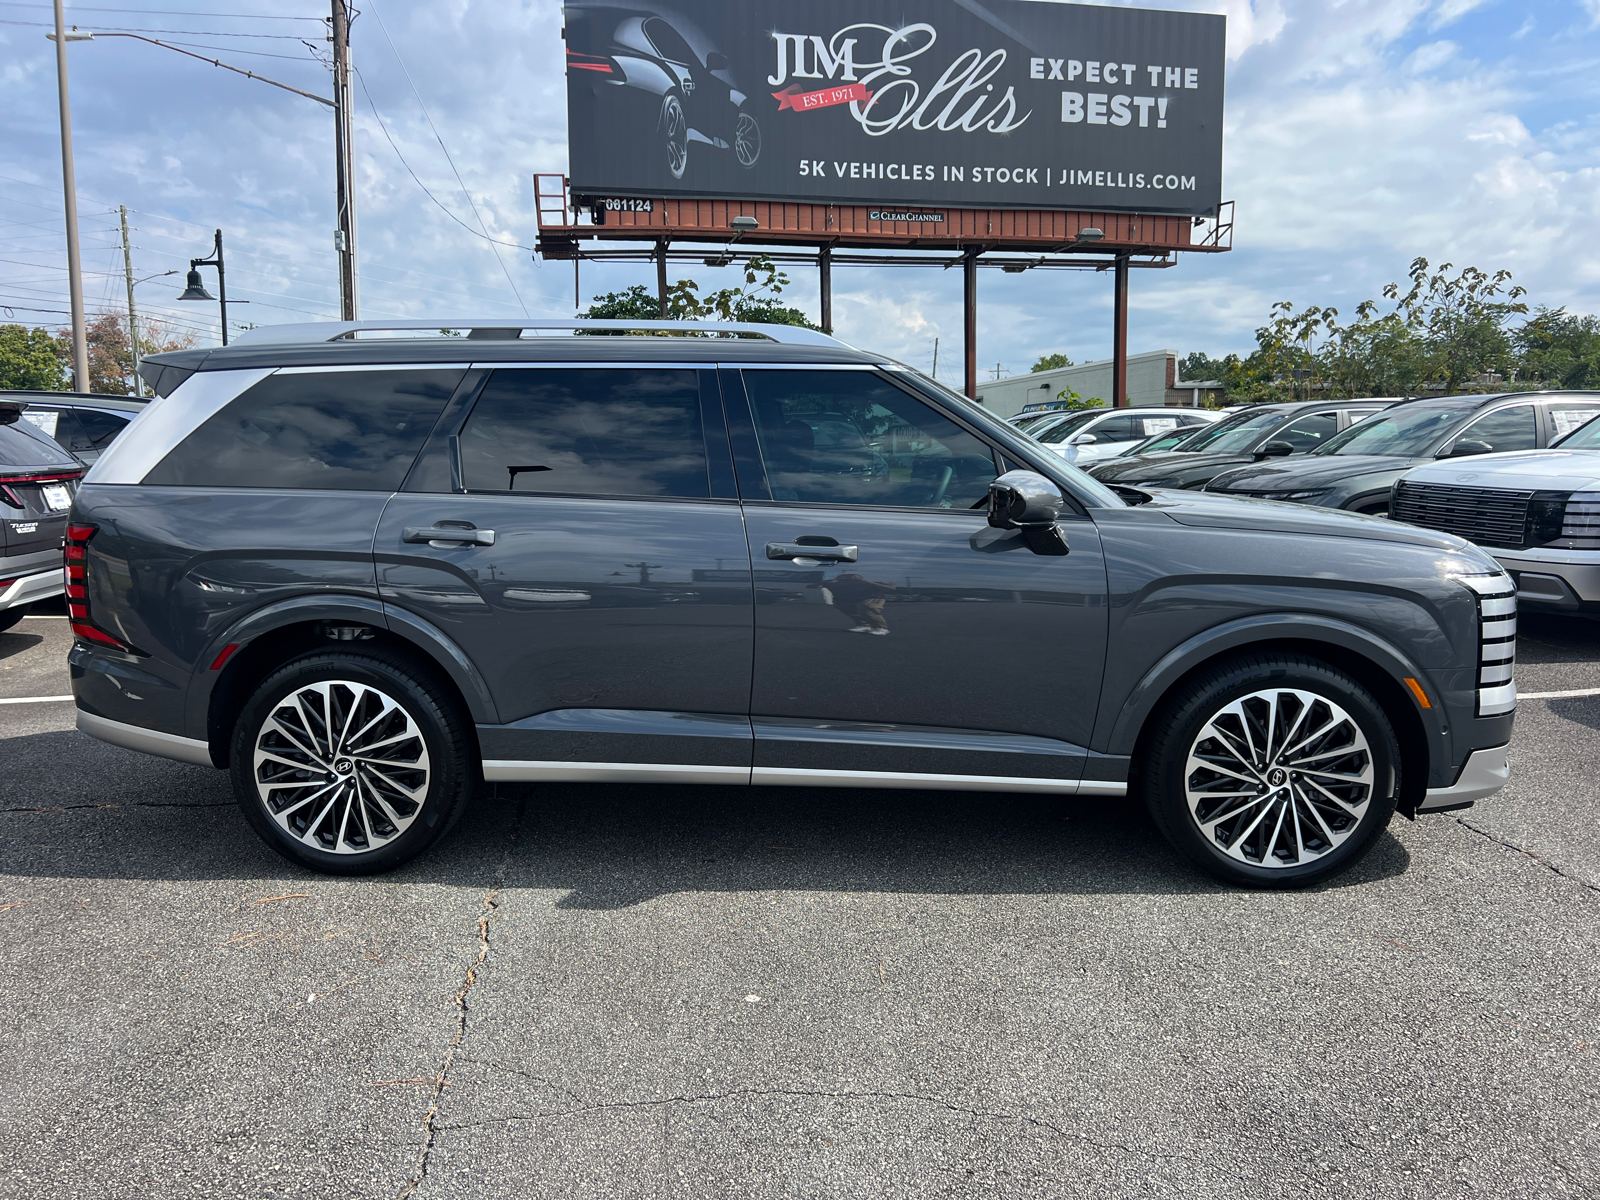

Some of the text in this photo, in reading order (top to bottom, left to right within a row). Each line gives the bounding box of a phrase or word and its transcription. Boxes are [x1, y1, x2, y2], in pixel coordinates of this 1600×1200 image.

[768, 23, 1033, 136] JIM Ellis
[1030, 57, 1198, 89] EXPECT THE
[803, 88, 854, 108] EST. 1971
[1061, 91, 1168, 128] BEST!
[799, 160, 825, 177] 5K
[834, 161, 935, 181] VEHICLES
[943, 166, 964, 182] IN
[972, 167, 1038, 184] STOCK
[1059, 169, 1196, 191] JIMELLIS.COM
[606, 198, 651, 212] 061124
